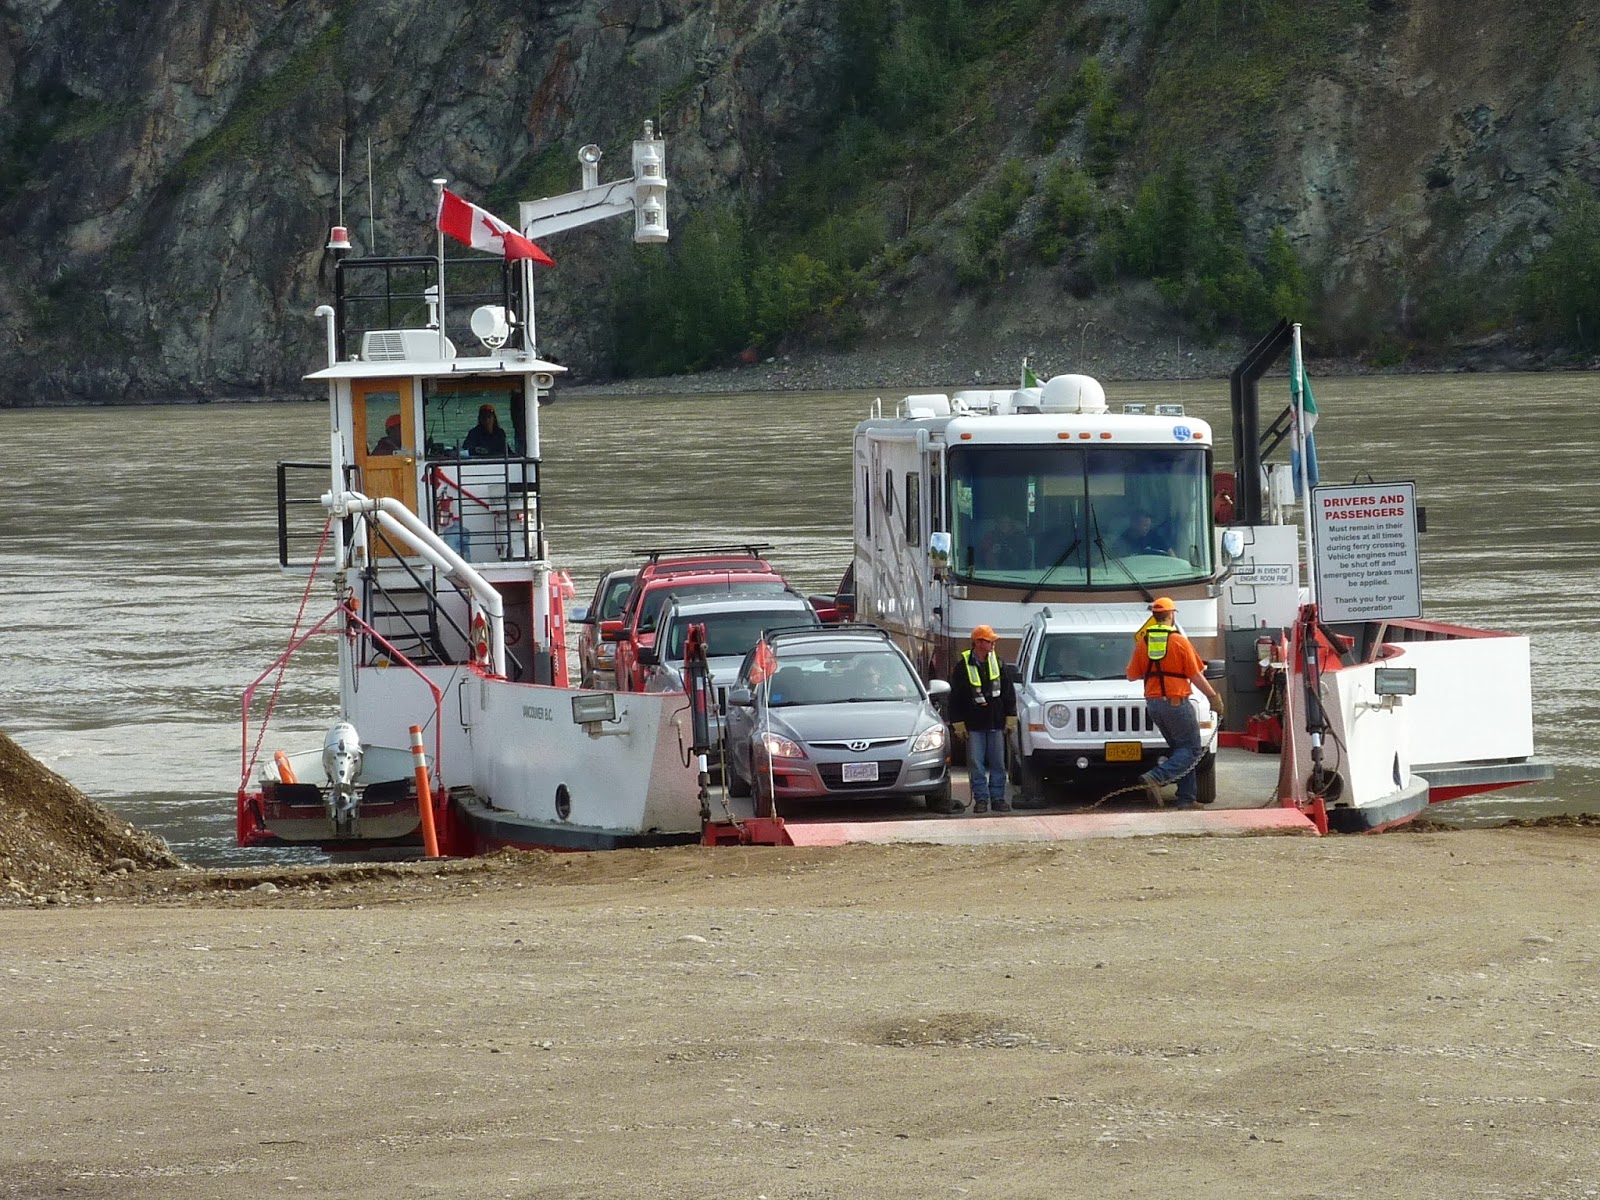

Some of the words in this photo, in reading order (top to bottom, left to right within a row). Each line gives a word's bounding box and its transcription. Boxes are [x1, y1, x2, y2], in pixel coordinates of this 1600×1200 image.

[1323, 496, 1376, 508] DRIVERS
[1379, 494, 1405, 504] AND
[1325, 507, 1405, 520] PASSENGERS
[1330, 534, 1360, 542] vehicles
[1382, 531, 1403, 539] times
[1326, 543, 1351, 552] during
[1352, 543, 1370, 551] ferry
[1372, 541, 1407, 550] crossing.
[1327, 552, 1355, 560] Vehicle
[1356, 552, 1386, 560] engines
[1388, 550, 1407, 558] must
[1381, 559, 1396, 567] and
[1323, 571, 1365, 579] emergency
[1366, 569, 1392, 577] brakes
[1359, 578, 1390, 587] applied.
[1334, 596, 1358, 604] Thank
[1359, 596, 1374, 604] you
[1375, 594, 1386, 602] for
[1387, 594, 1405, 603] your
[1347, 604, 1393, 613] cooperation
